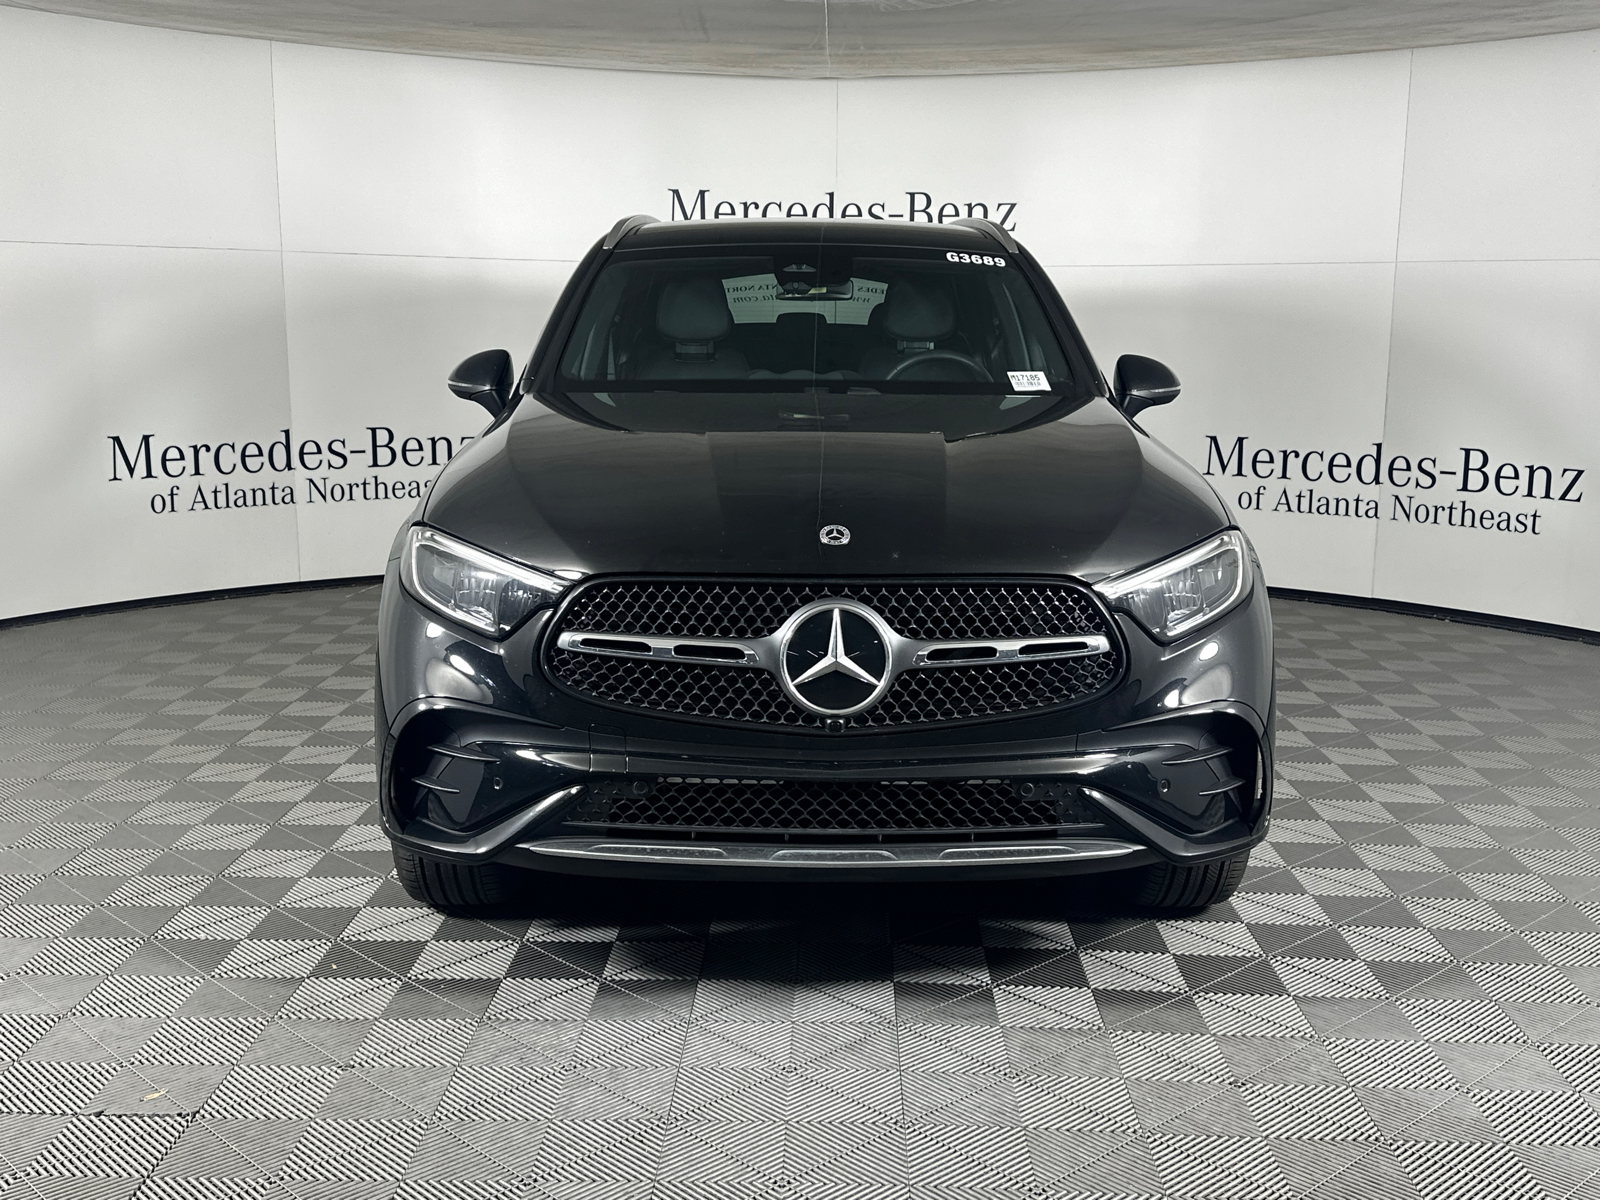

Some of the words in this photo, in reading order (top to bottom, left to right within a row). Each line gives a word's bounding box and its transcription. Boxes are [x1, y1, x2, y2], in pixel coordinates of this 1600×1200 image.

[668, 188, 1018, 232] Mercedes-Benz
[946, 251, 1006, 268] G3689
[1202, 434, 1586, 503] Mercedes-Benz
[150, 485, 179, 515] of
[188, 481, 297, 513] Atlanta
[306, 476, 437, 504] Northea
[1237, 485, 1266, 511] of
[1272, 487, 1380, 520] Atlanta
[1390, 494, 1542, 535] Northeast
